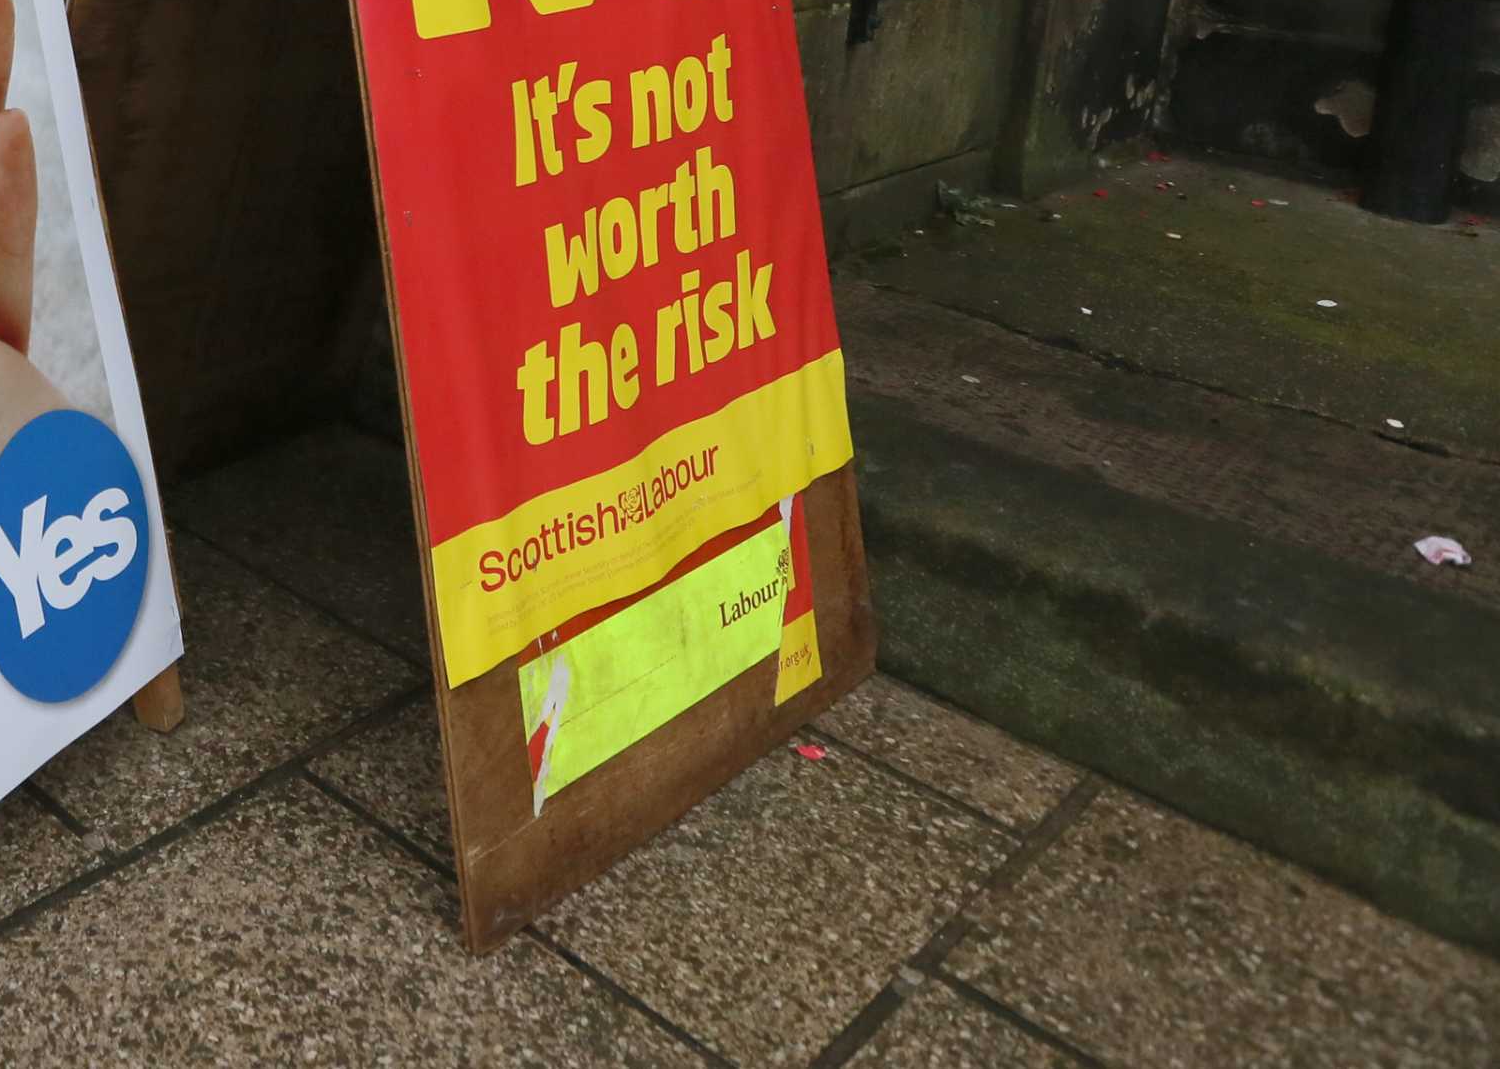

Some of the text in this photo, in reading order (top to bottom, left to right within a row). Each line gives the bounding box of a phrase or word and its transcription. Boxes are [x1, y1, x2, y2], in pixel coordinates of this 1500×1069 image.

[511, 33, 733, 187] It's not
[544, 146, 736, 309] worth
[516, 249, 777, 446] the risk
[478, 502, 620, 593] Scottish
[641, 444, 720, 519] Labour
[718, 577, 779, 629] Labour
